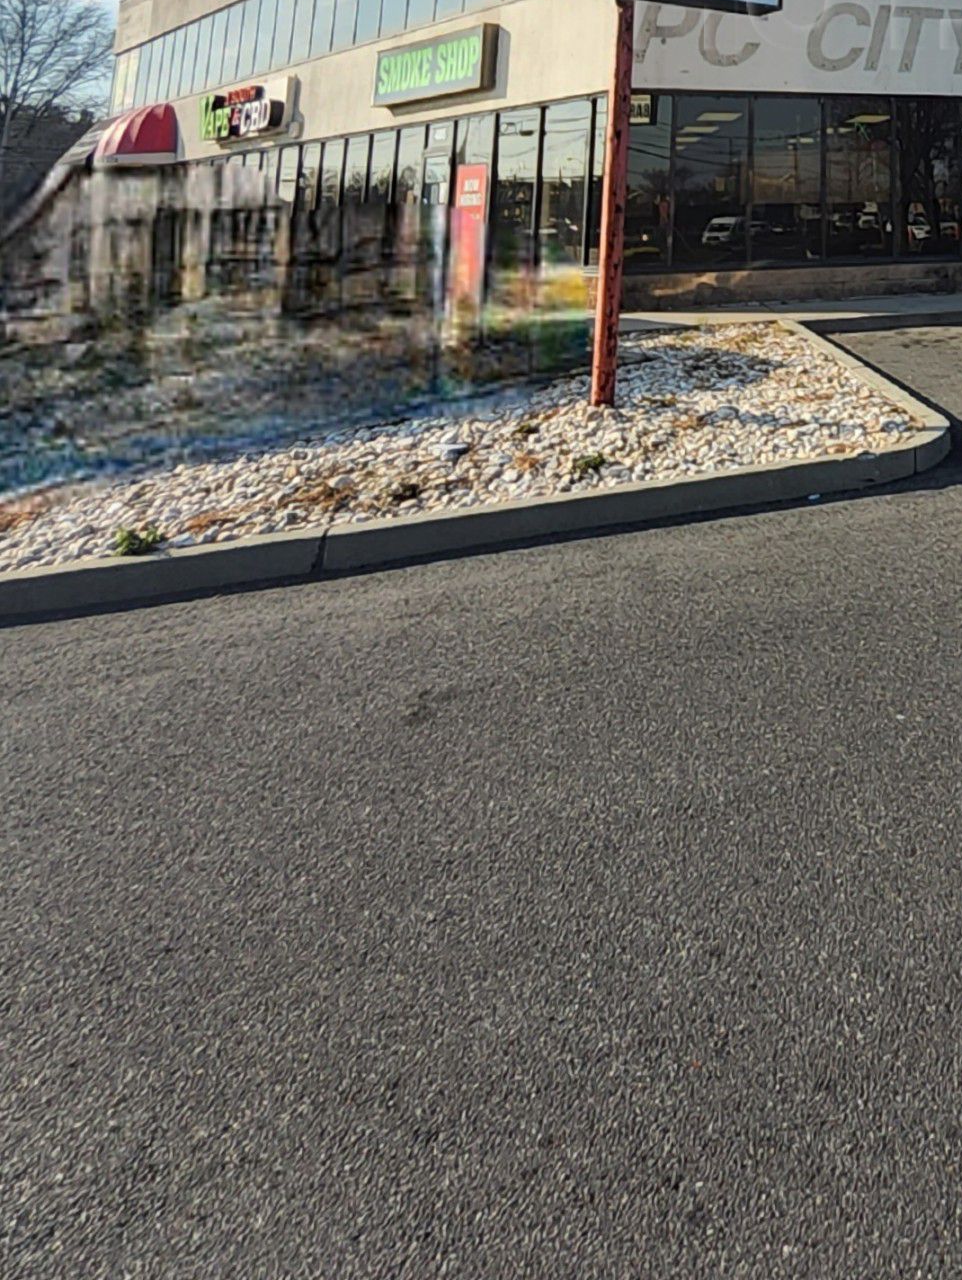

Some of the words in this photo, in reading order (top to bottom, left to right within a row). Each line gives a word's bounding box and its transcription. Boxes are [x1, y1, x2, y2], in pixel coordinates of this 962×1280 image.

[378, 46, 433, 95] SMOKE
[435, 35, 480, 85] SHOP
[635, 4, 761, 67] PC
[240, 100, 271, 136] CBD
